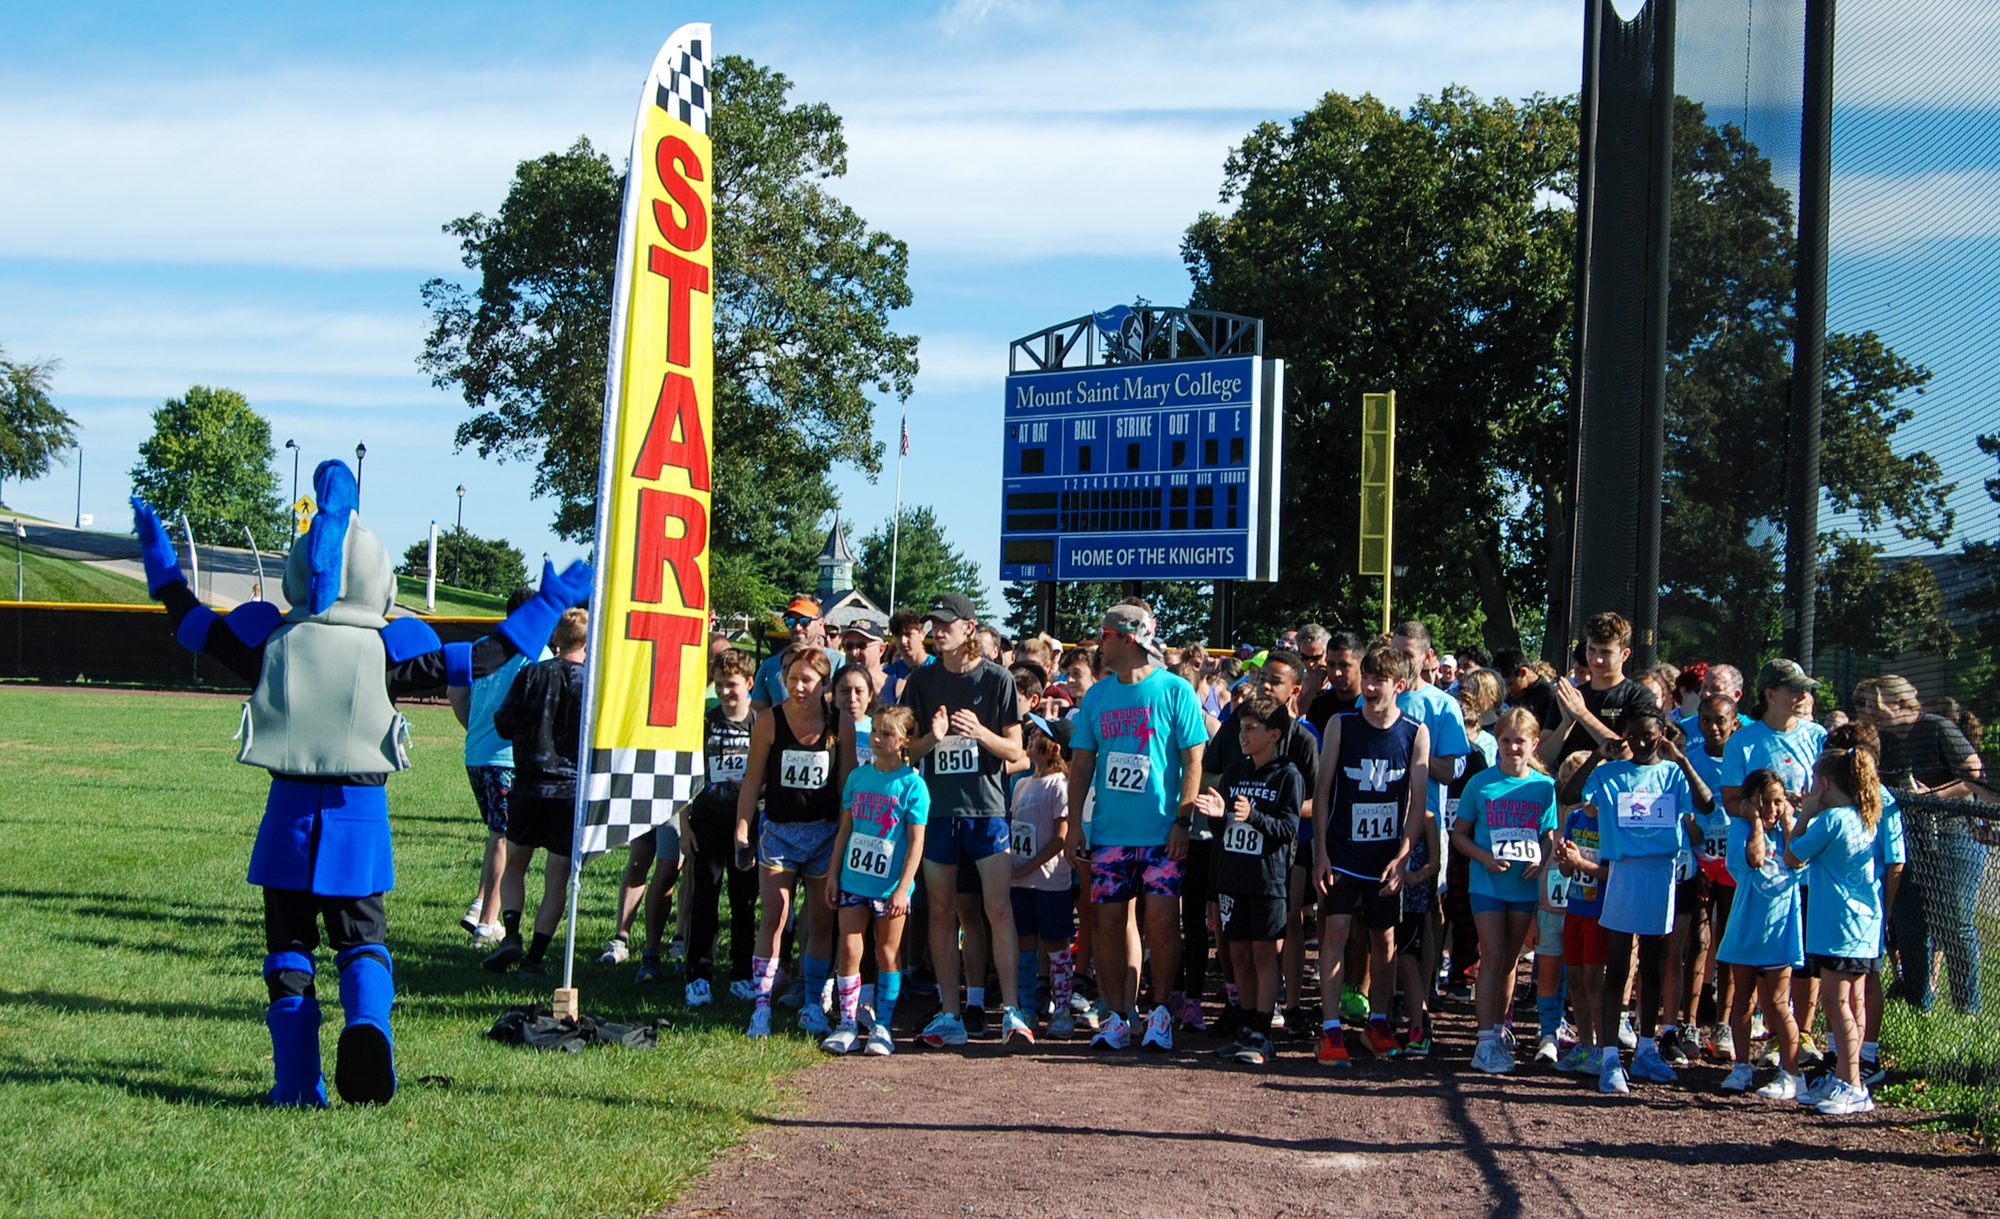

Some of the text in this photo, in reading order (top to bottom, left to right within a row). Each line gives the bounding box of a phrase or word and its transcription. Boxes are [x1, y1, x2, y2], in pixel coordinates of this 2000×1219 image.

[1015, 371, 1242, 409] Mount Saint Mary College
[625, 135, 711, 728] START
[1074, 419, 1097, 440] BALL
[1116, 415, 1152, 438] STRIKE
[1168, 413, 1190, 436] OUT
[1208, 411, 1216, 433] H
[1234, 410, 1241, 432] E
[1018, 422, 1049, 443] AT BAT
[1196, 472, 1212, 485] HITS
[1219, 471, 1246, 484] ERRORS
[1071, 546, 1235, 567] HOME OF THE KNIGHTS
[1021, 565, 1036, 577] TIME
[1101, 718, 1139, 740] BOLTS
[715, 755, 744, 771] 742
[938, 749, 973, 772] 850
[784, 765, 824, 786] 443
[1107, 766, 1144, 790] 422
[1228, 786, 1277, 802] YANKEES
[1485, 799, 1543, 813] NEWBURGH
[1656, 807, 1664, 819] 1
[1356, 817, 1394, 839] 414
[1486, 810, 1529, 829] BOLTS
[1225, 827, 1259, 852] 198
[1496, 839, 1536, 859] 756
[849, 846, 888, 876] 846
